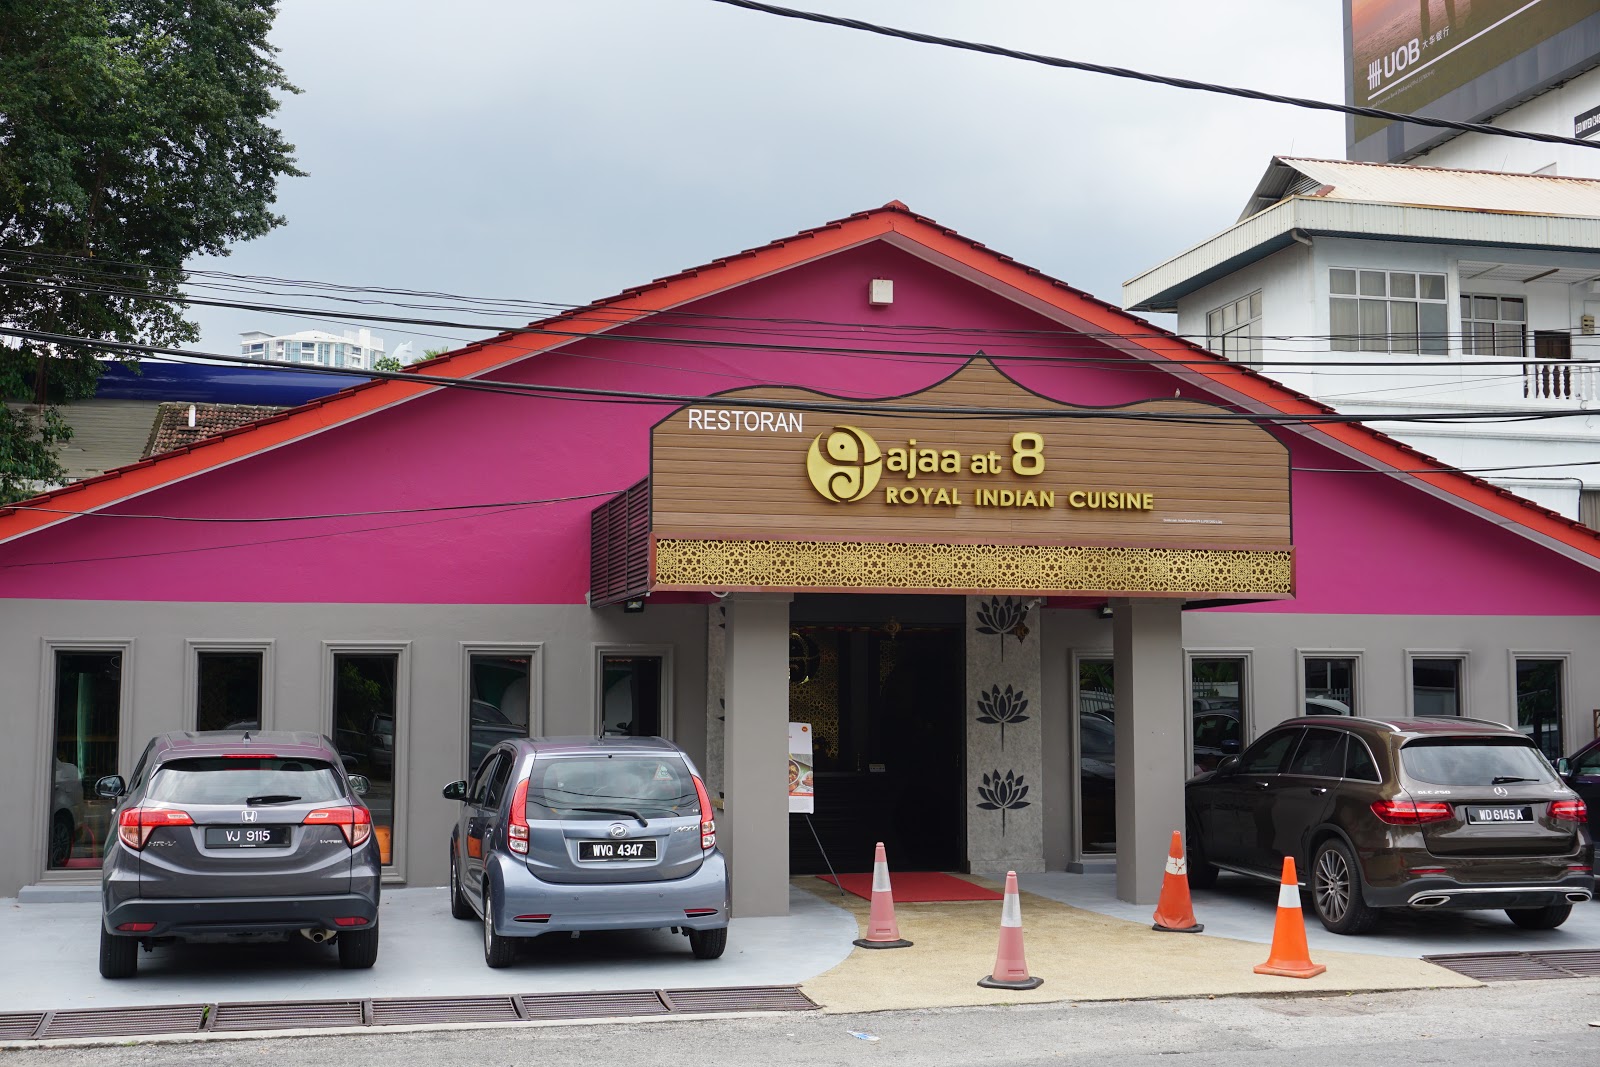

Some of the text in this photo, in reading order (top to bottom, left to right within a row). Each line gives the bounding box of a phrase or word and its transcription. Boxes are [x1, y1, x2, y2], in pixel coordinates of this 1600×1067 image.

[1384, 37, 1420, 79] UOB
[688, 408, 803, 433] RESTORAN
[970, 450, 1002, 475] at
[1012, 431, 1046, 477] 8
[886, 486, 1154, 511] ROYAL INDIAN CUISINE
[1479, 809, 1524, 821] WD 6145 A
[226, 830, 271, 842] VJ 9115
[592, 843, 644, 857] WVQ 4347
